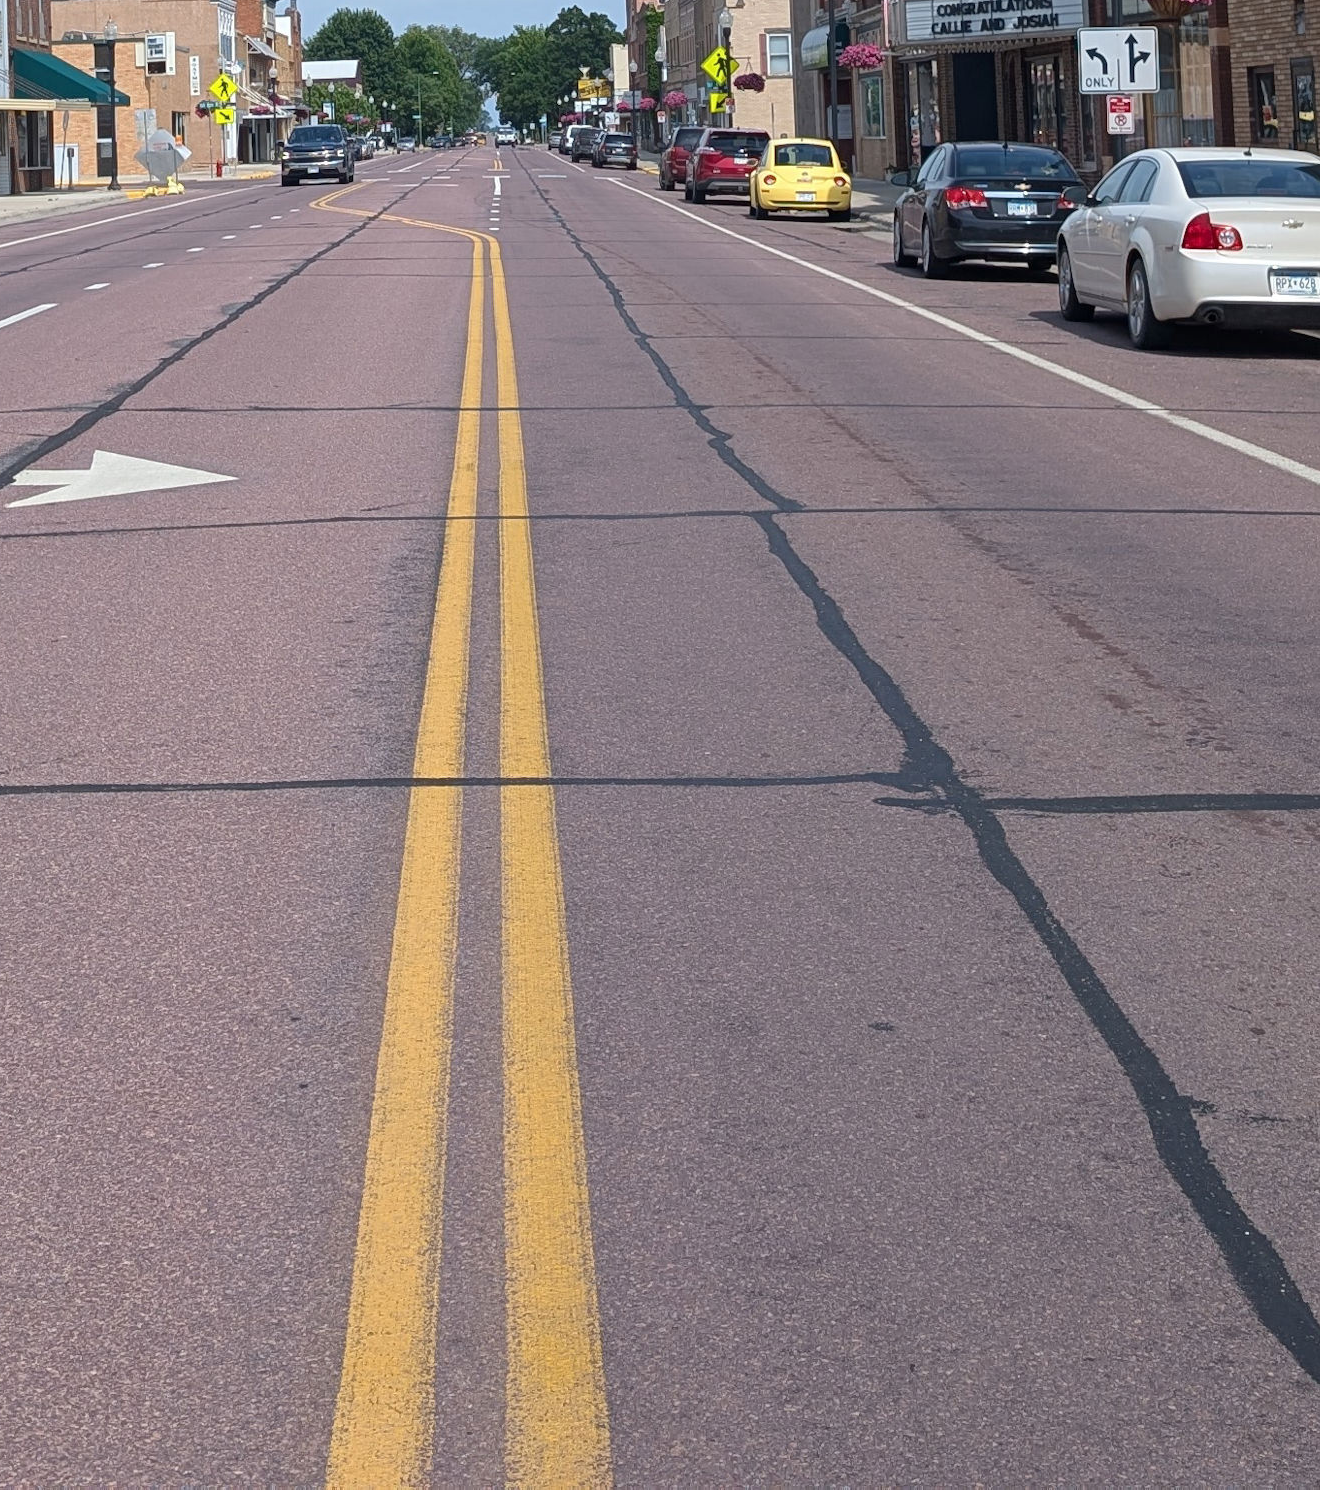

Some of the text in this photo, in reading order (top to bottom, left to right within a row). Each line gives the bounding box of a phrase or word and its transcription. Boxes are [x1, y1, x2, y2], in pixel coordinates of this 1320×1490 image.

[932, 13, 1059, 35] CALLIE AND JOSIAH
[1085, 77, 1115, 88] ONLY
[1275, 277, 1293, 289] RPX
